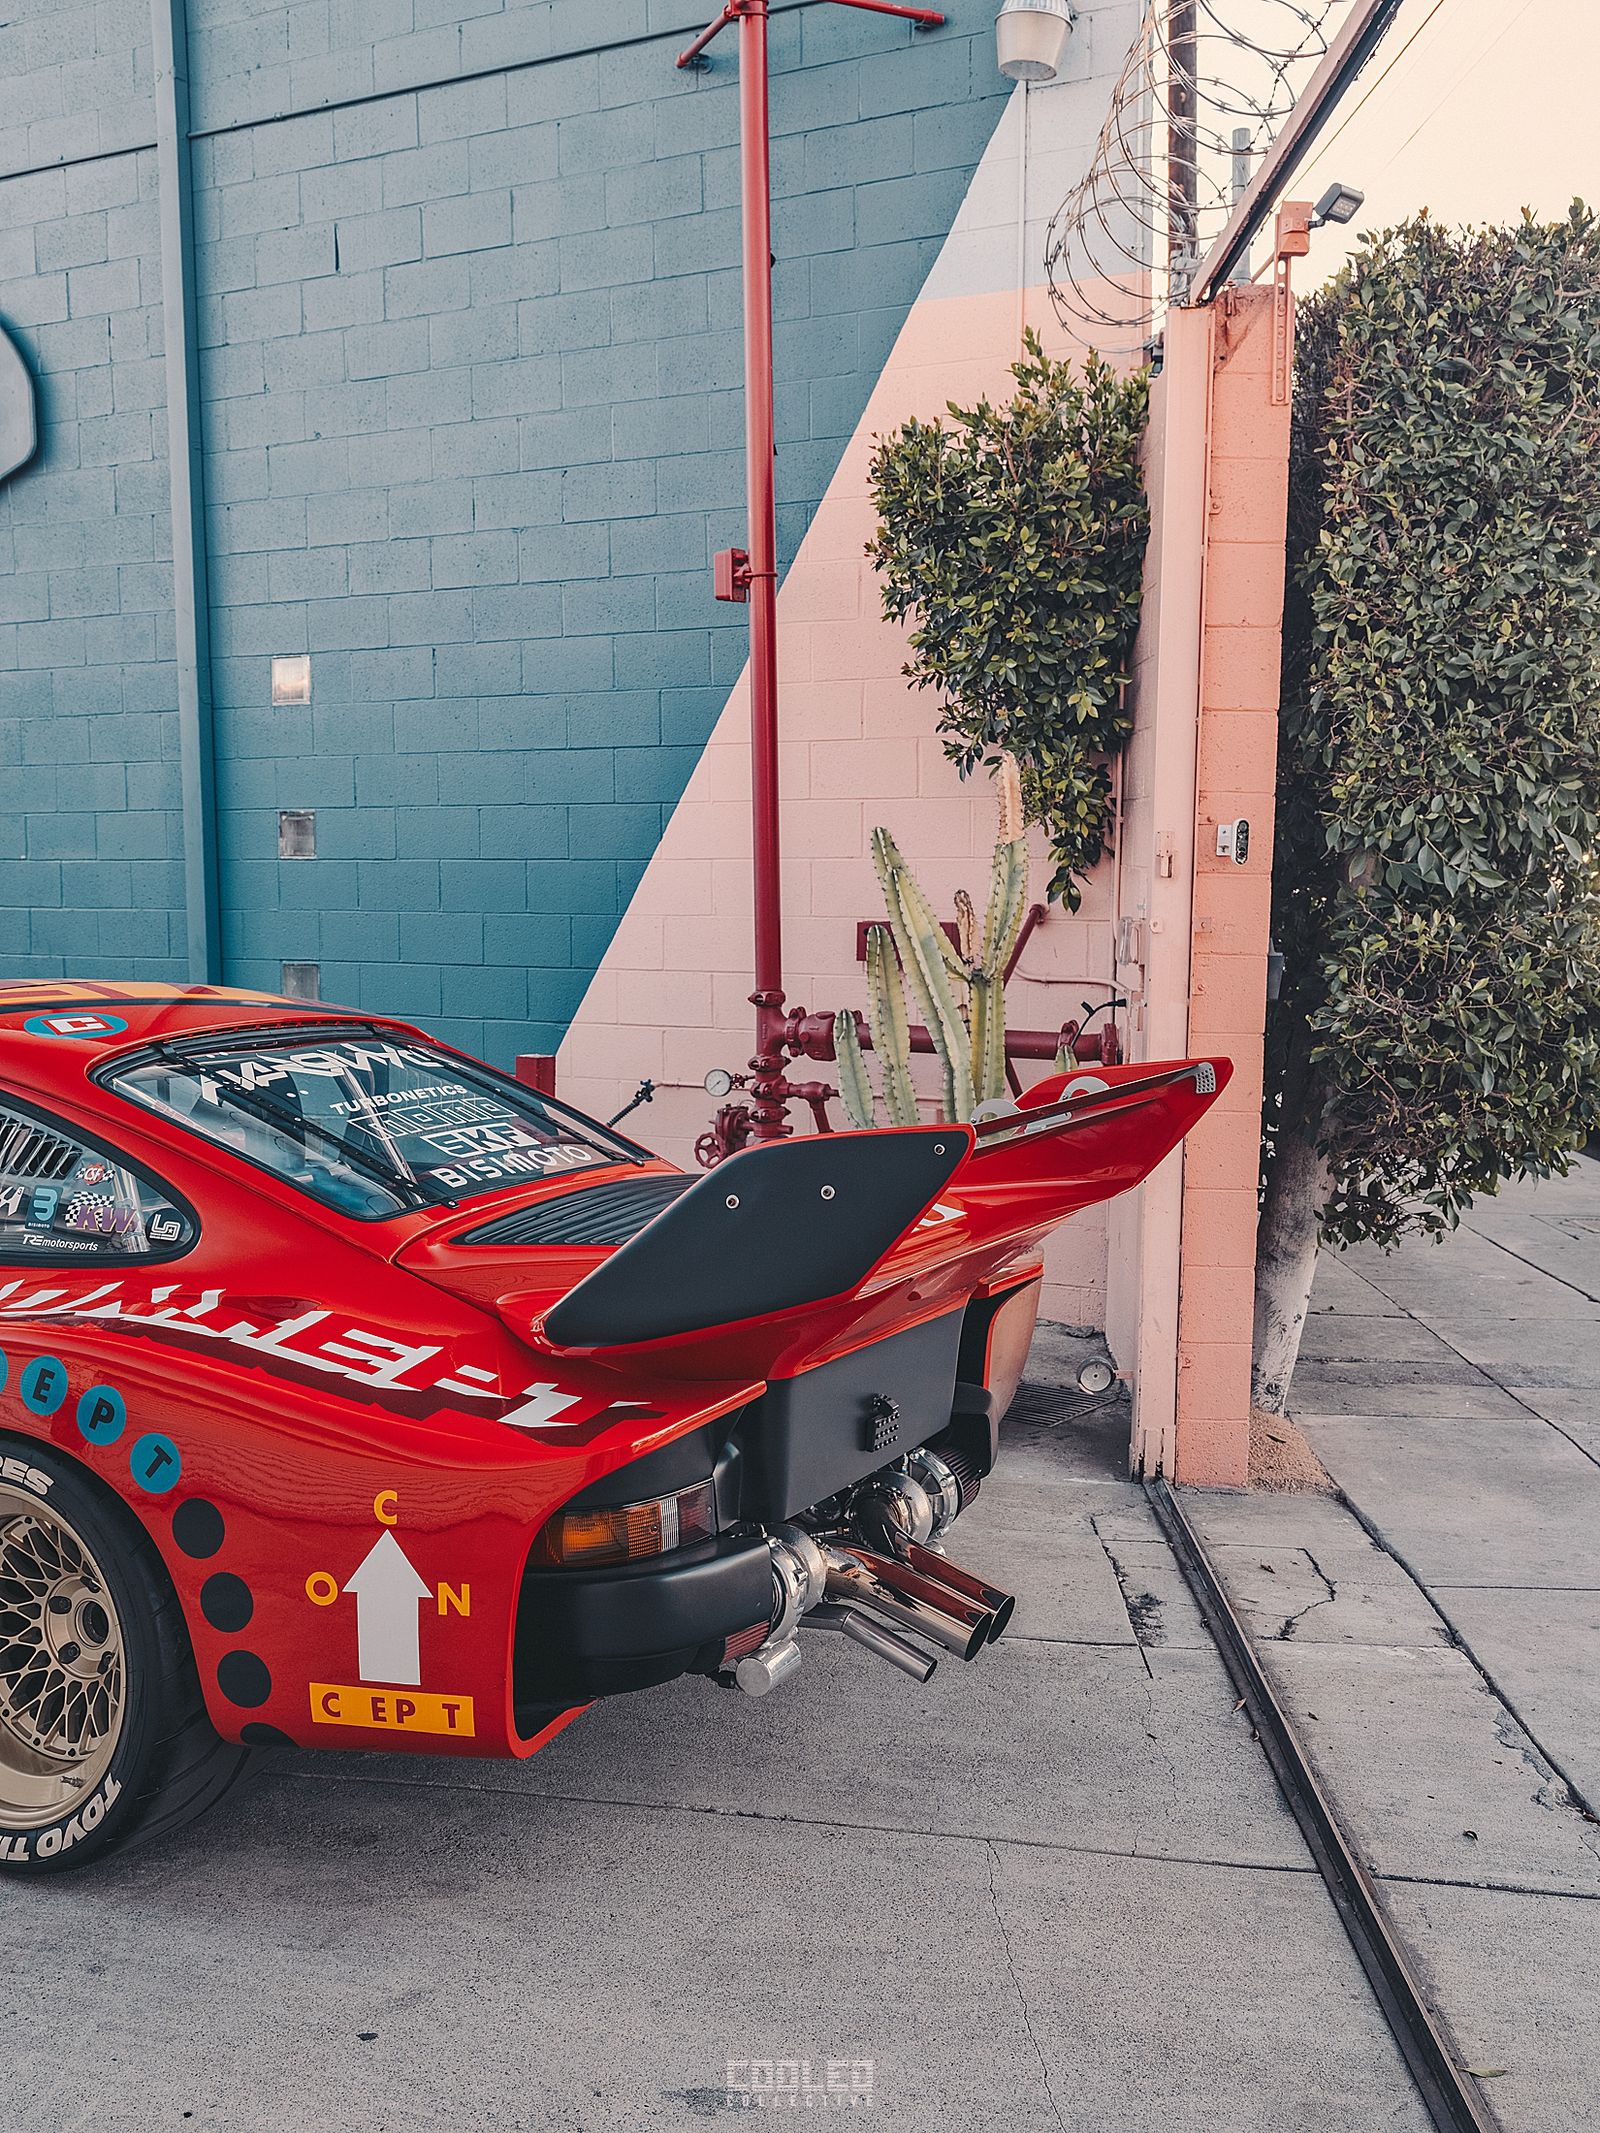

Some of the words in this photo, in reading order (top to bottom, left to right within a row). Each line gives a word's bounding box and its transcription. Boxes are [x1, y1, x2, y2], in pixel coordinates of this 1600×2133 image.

[329, 1084, 468, 1116] TURBONETICS
[429, 1145, 593, 1189] BISIMOTO
[76, 1205, 137, 1234] KW
[36, 1771, 122, 1858] TOYO
